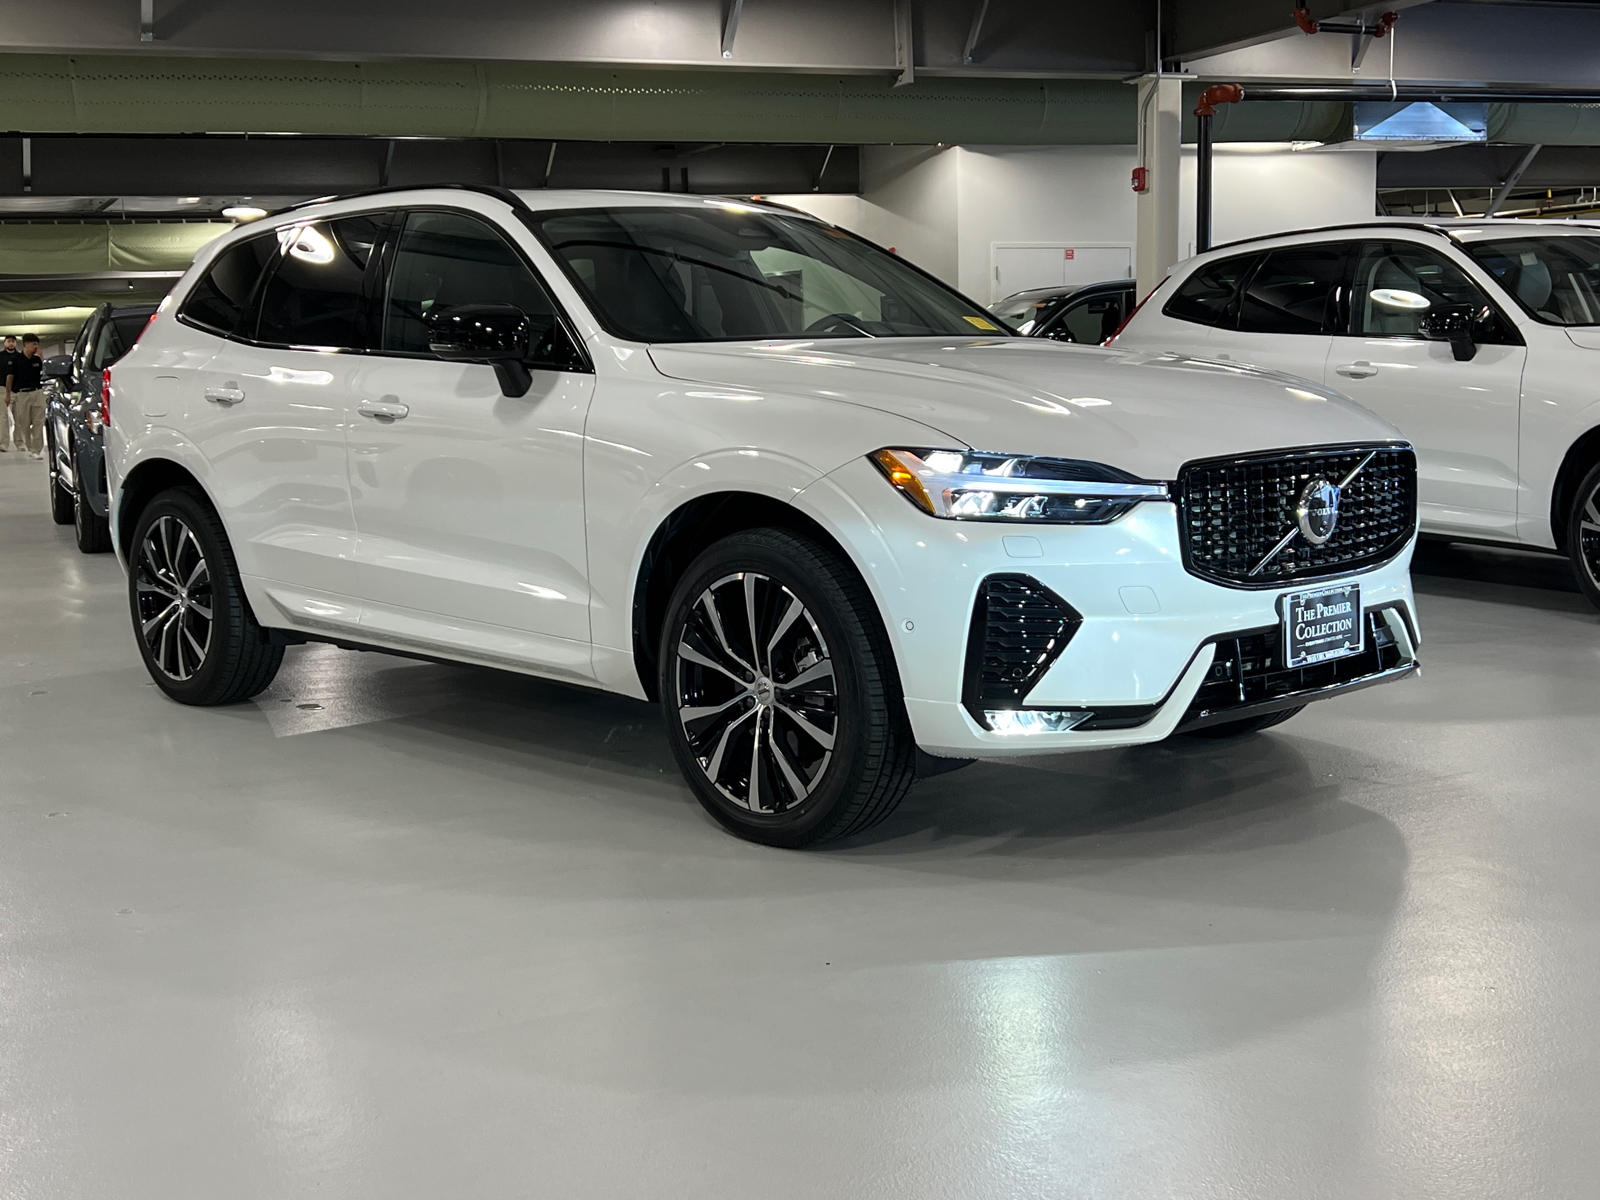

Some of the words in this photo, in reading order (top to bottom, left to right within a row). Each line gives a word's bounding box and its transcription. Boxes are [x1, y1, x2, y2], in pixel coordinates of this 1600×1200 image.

[1295, 606, 1316, 623] THE
[1316, 601, 1352, 619] PREMIER
[1295, 618, 1352, 640] COLLECTION
